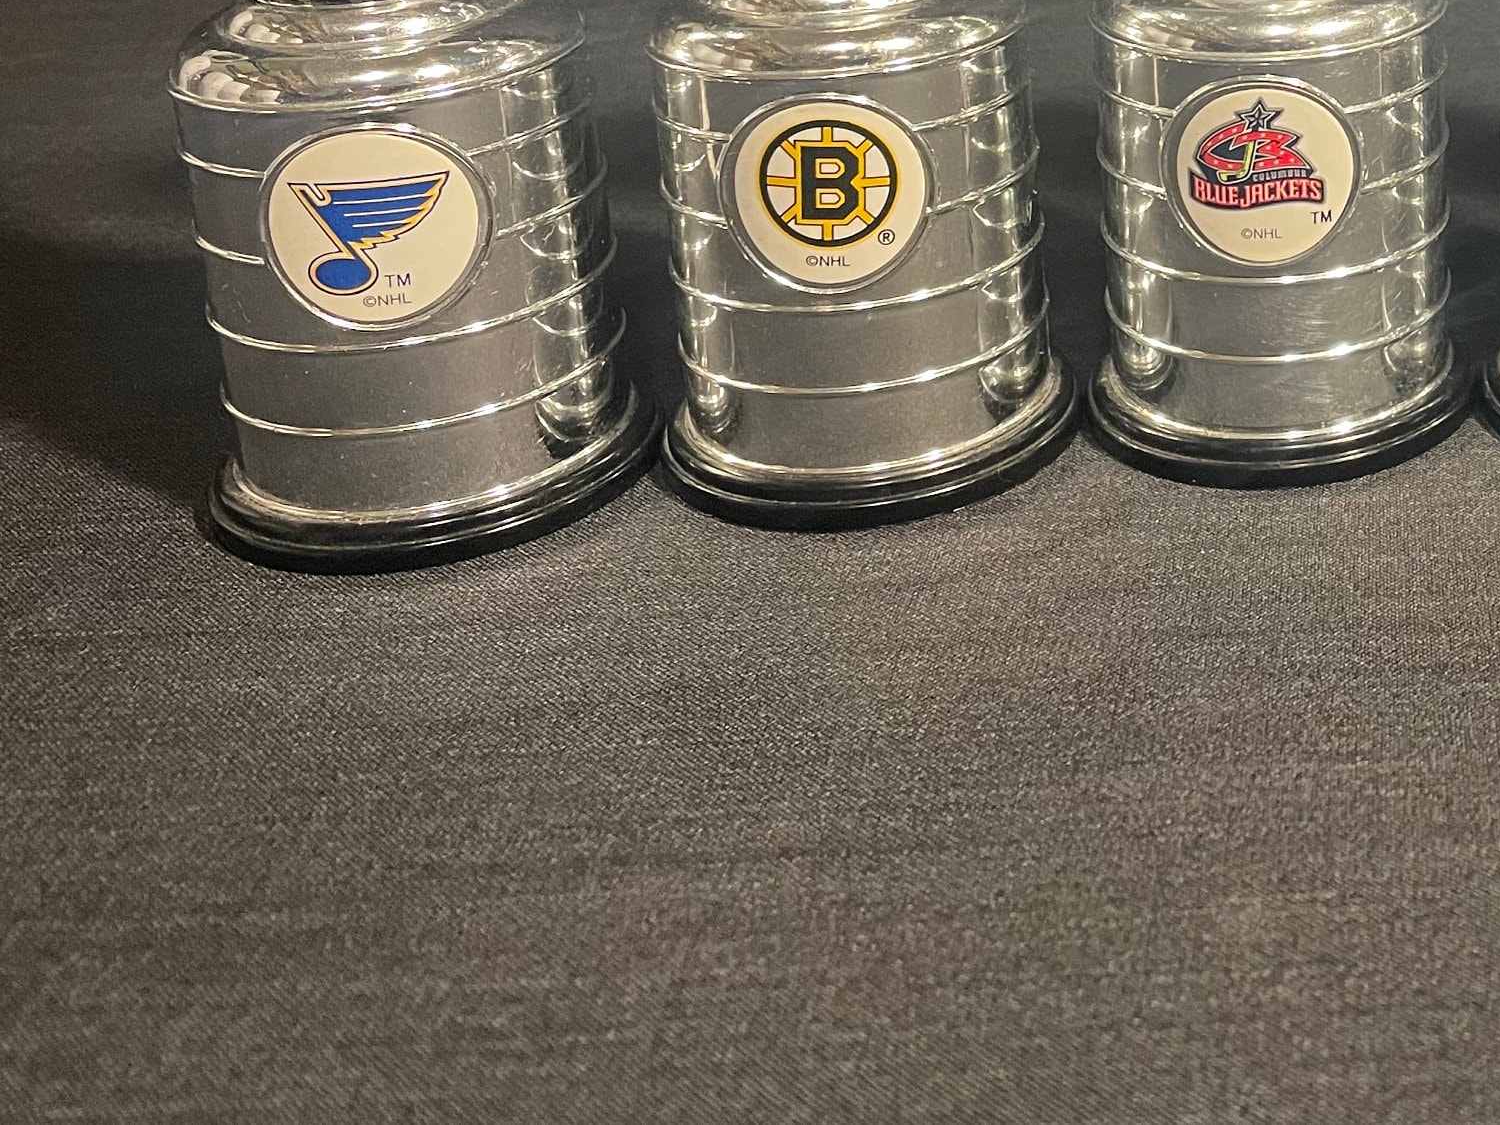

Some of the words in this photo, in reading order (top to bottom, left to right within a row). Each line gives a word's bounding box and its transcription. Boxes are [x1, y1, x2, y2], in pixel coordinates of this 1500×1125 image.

[1194, 178, 1239, 206] BLUE
[1240, 179, 1322, 208] JACKETS
[1311, 210, 1332, 224] TM
[384, 273, 411, 288] TM
